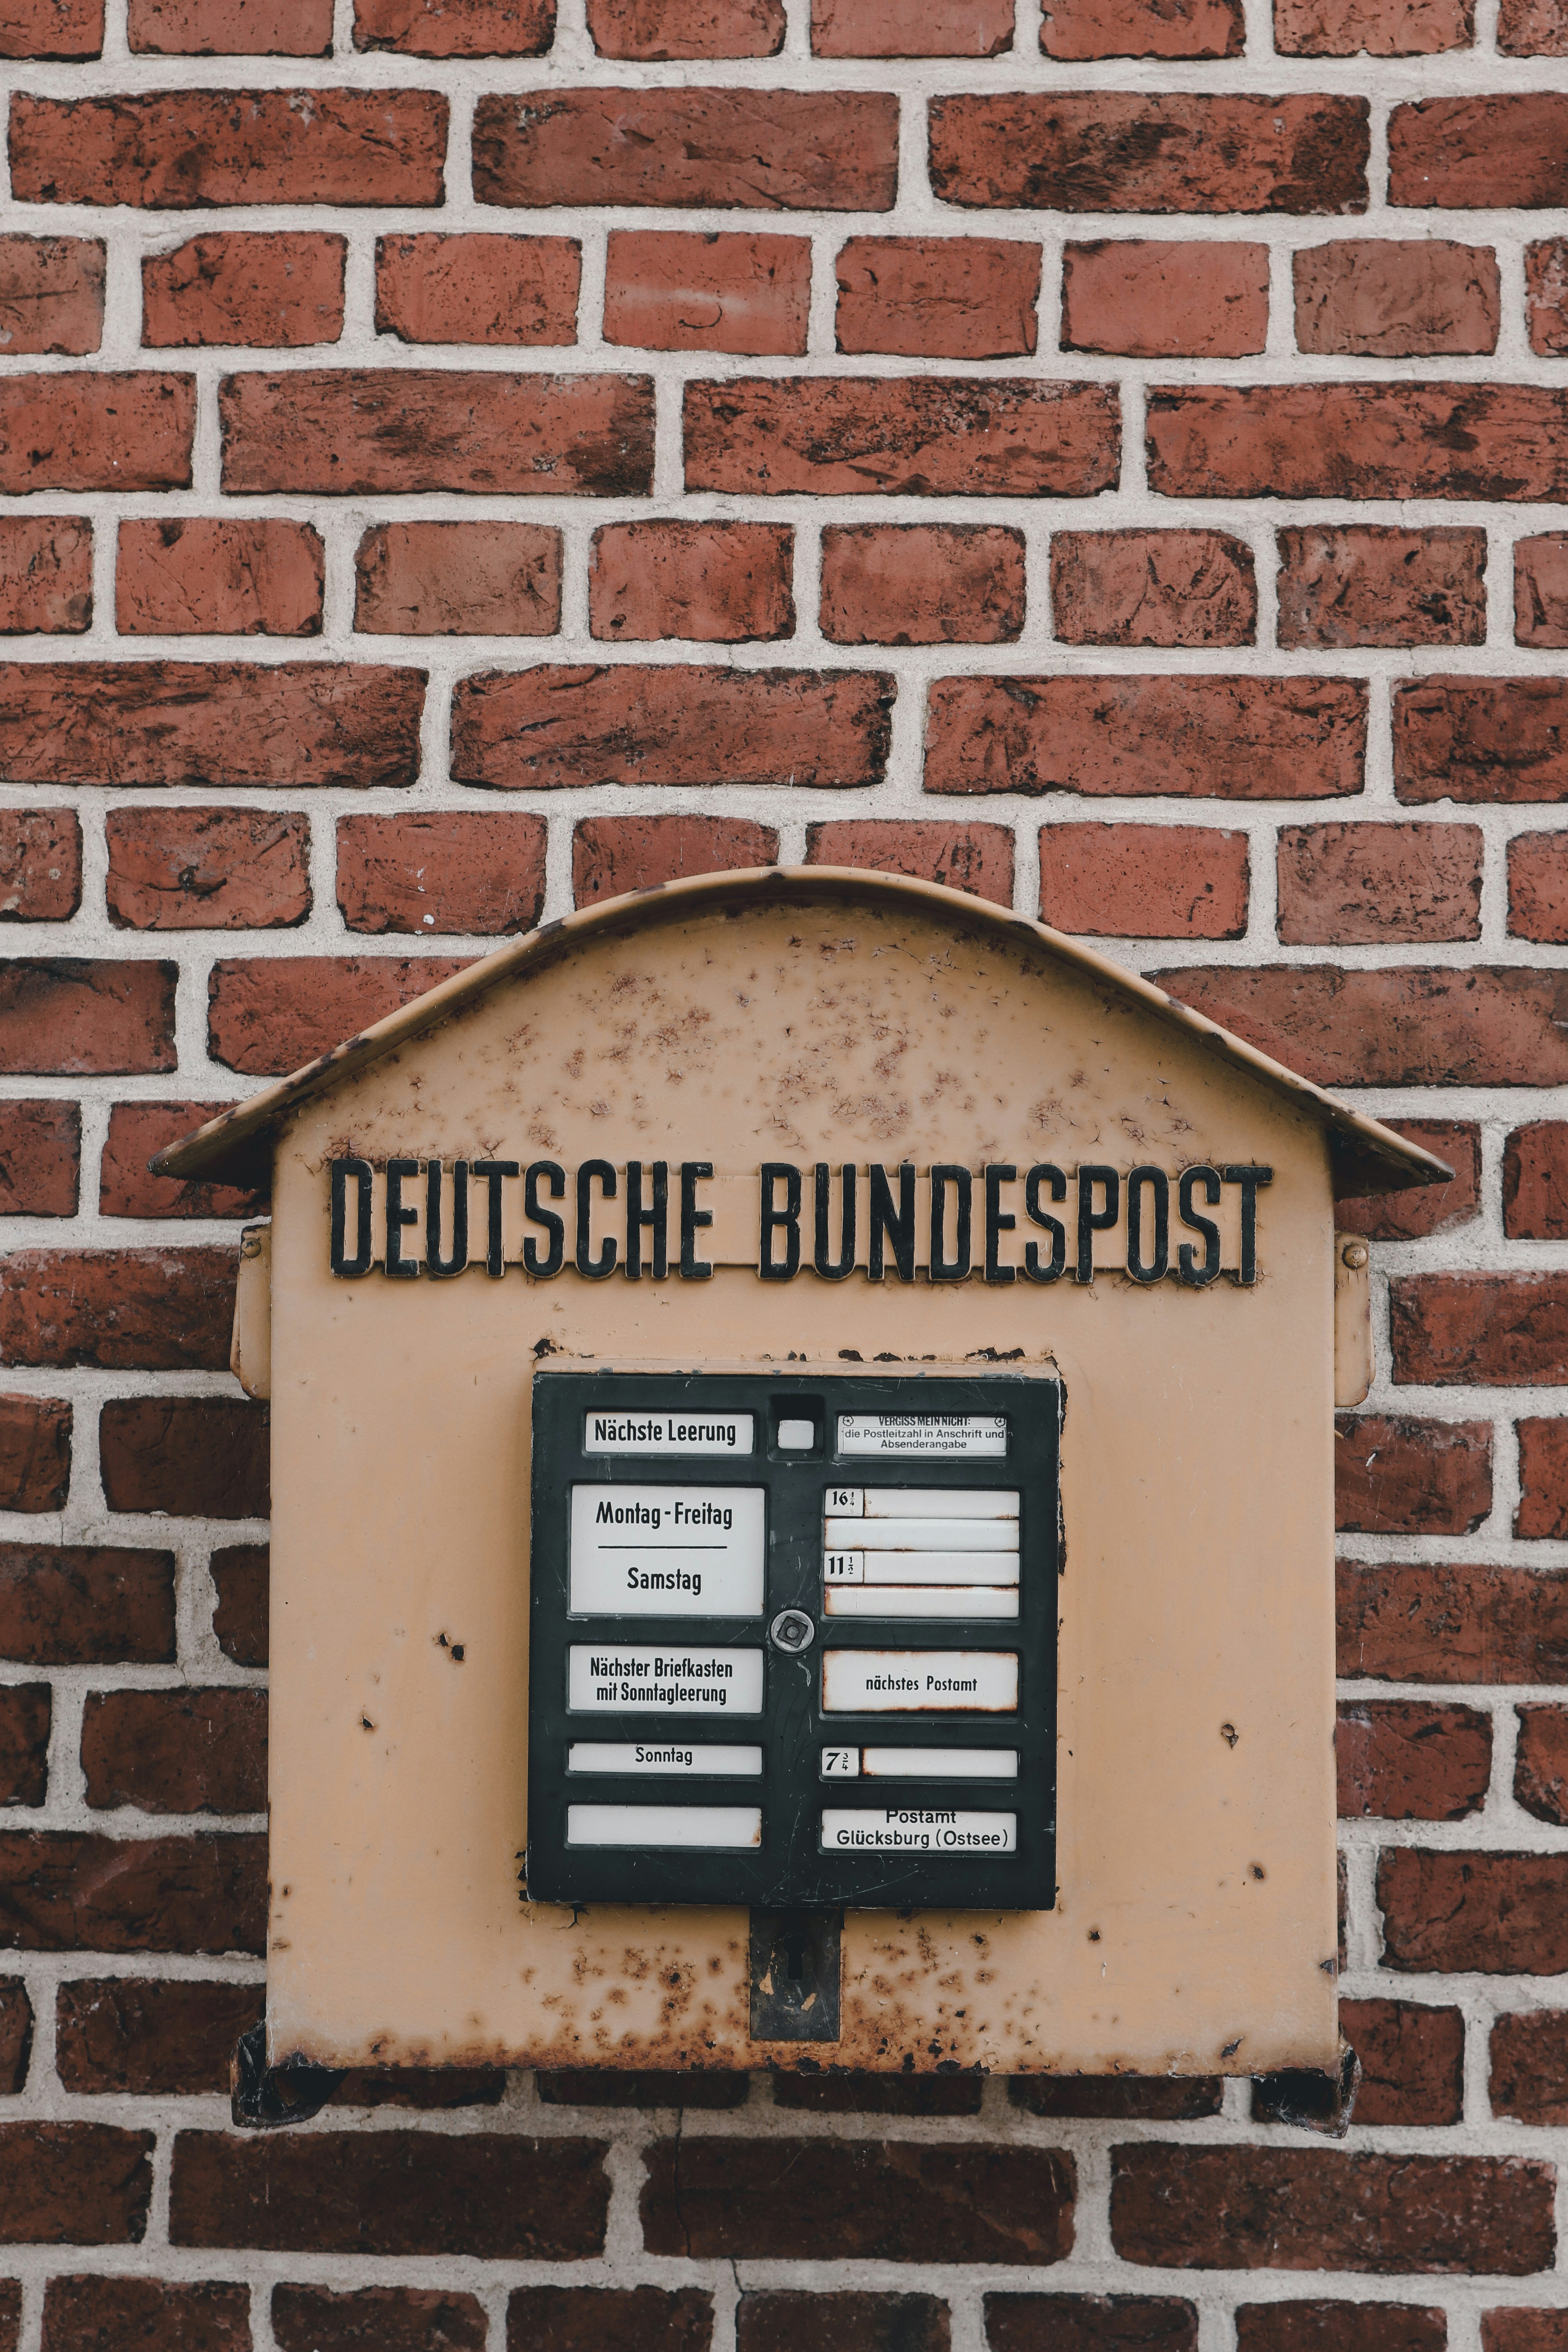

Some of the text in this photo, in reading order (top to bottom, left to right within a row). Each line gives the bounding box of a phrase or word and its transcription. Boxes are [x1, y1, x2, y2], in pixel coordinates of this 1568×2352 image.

[330, 1159, 1273, 1285] DEUTSCHE BUNDESPOST
[878, 1416, 916, 1426] VERGISS
[595, 1419, 736, 1446] Nächste Leerung
[845, 1429, 1004, 1439] die Postleitzahl in Anschrift und
[880, 1439, 967, 1450] Absenderangabe
[627, 1567, 701, 1596] Samstag
[590, 1657, 733, 1678] Nächster Briefkasten
[866, 1674, 978, 1691] nächstes Postamt
[596, 1682, 727, 1706] mit Sonntagleerung
[635, 1746, 693, 1766] Sonntag
[886, 1810, 956, 1824] Postamt
[837, 1828, 1008, 1849] Glücksburg (Ostsee)
